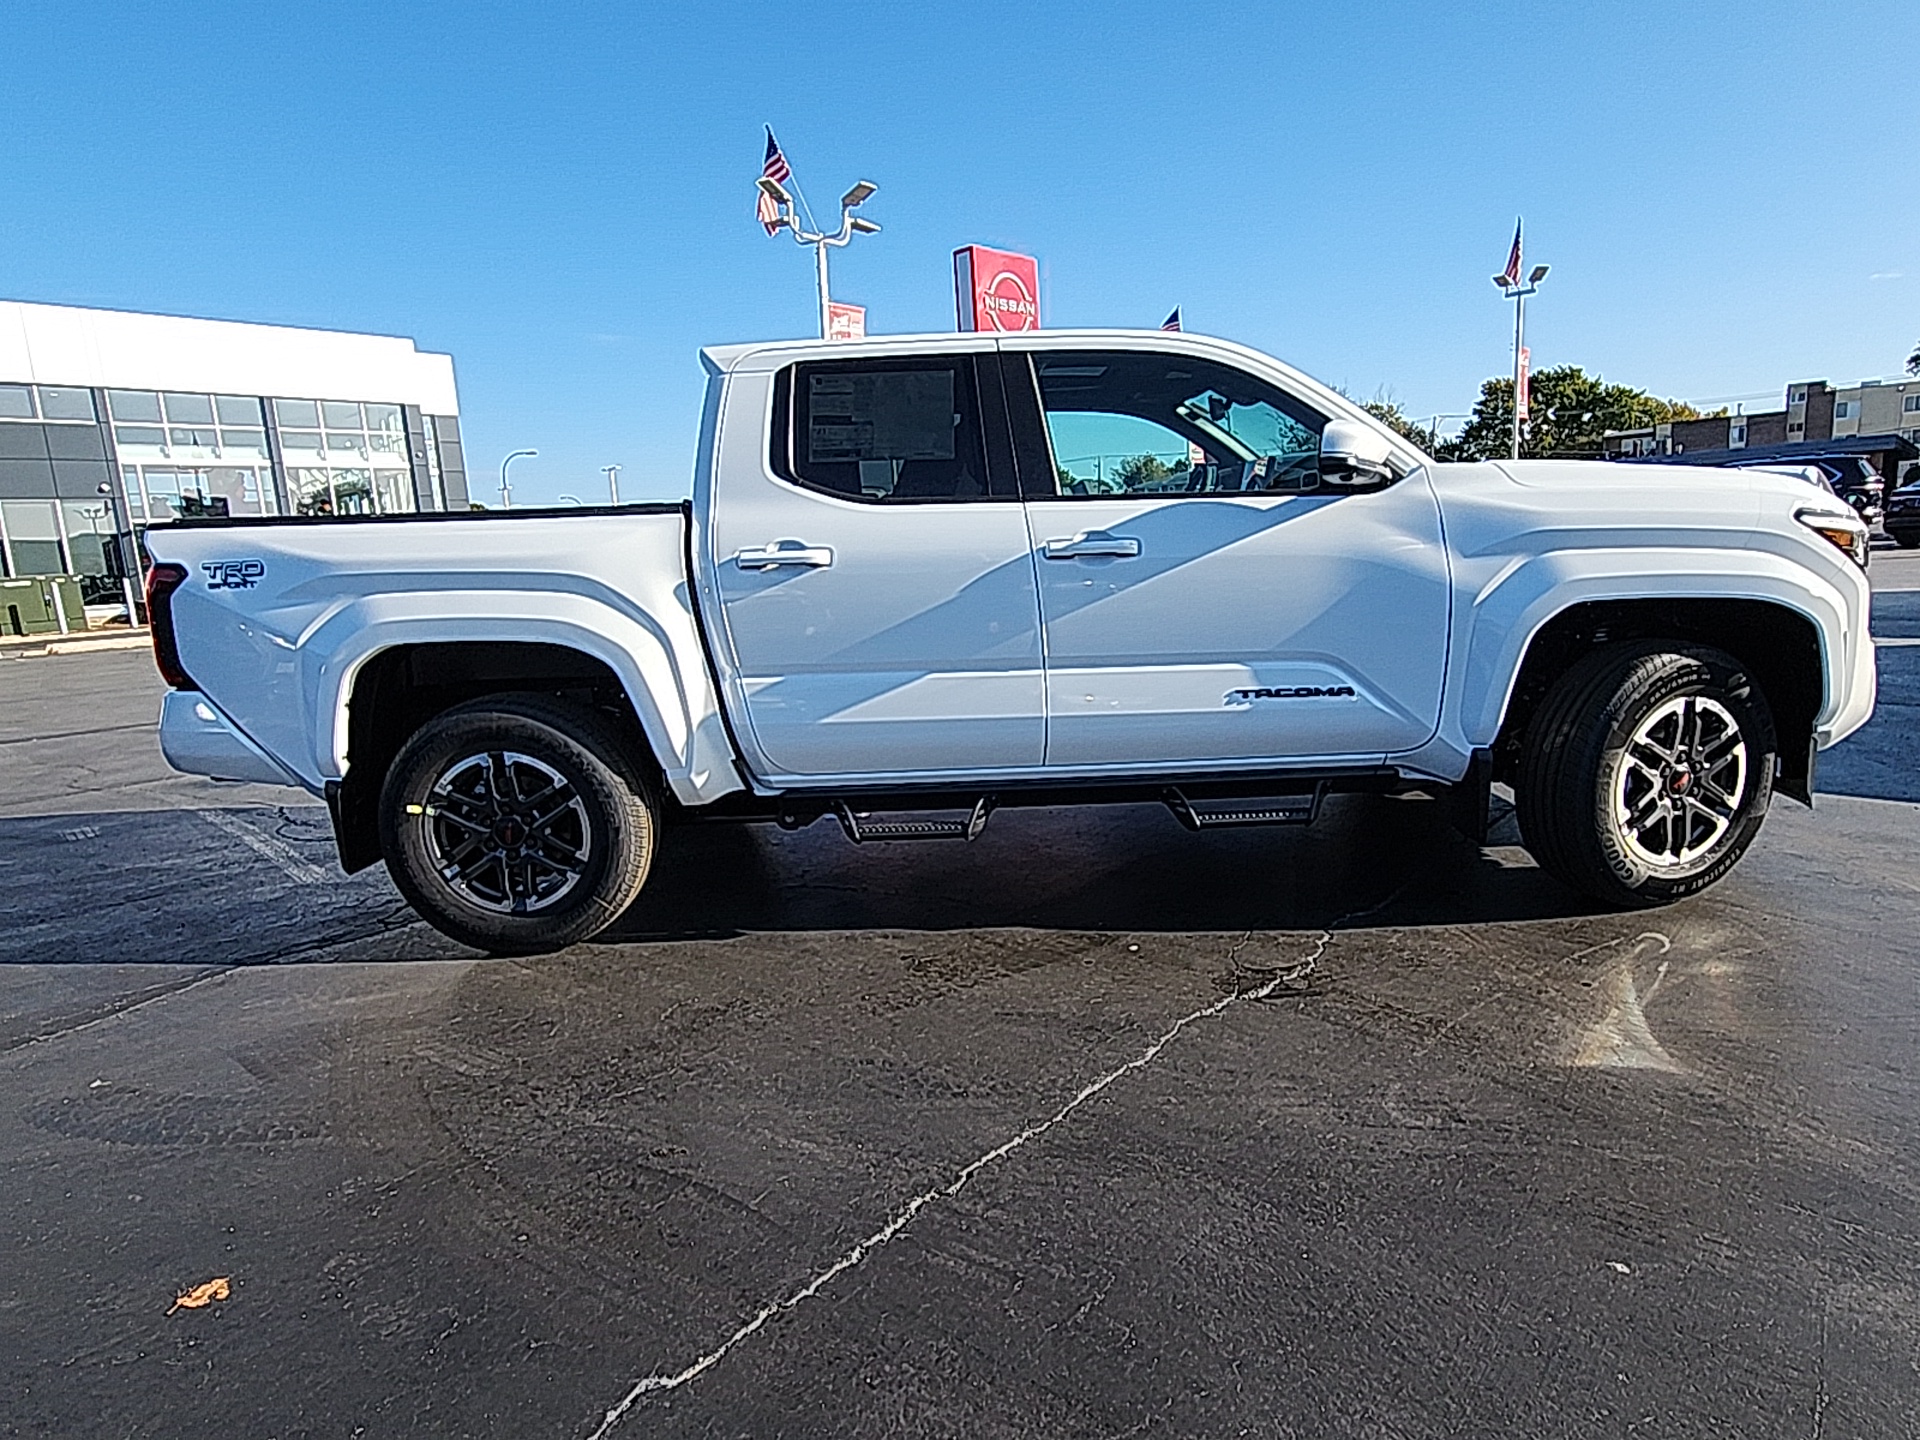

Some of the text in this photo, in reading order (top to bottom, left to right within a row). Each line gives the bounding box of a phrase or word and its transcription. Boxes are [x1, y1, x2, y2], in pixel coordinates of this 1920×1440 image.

[983, 296, 1035, 315] NISSAN
[201, 559, 265, 582] TRD
[1233, 686, 1356, 699] TACOMA
